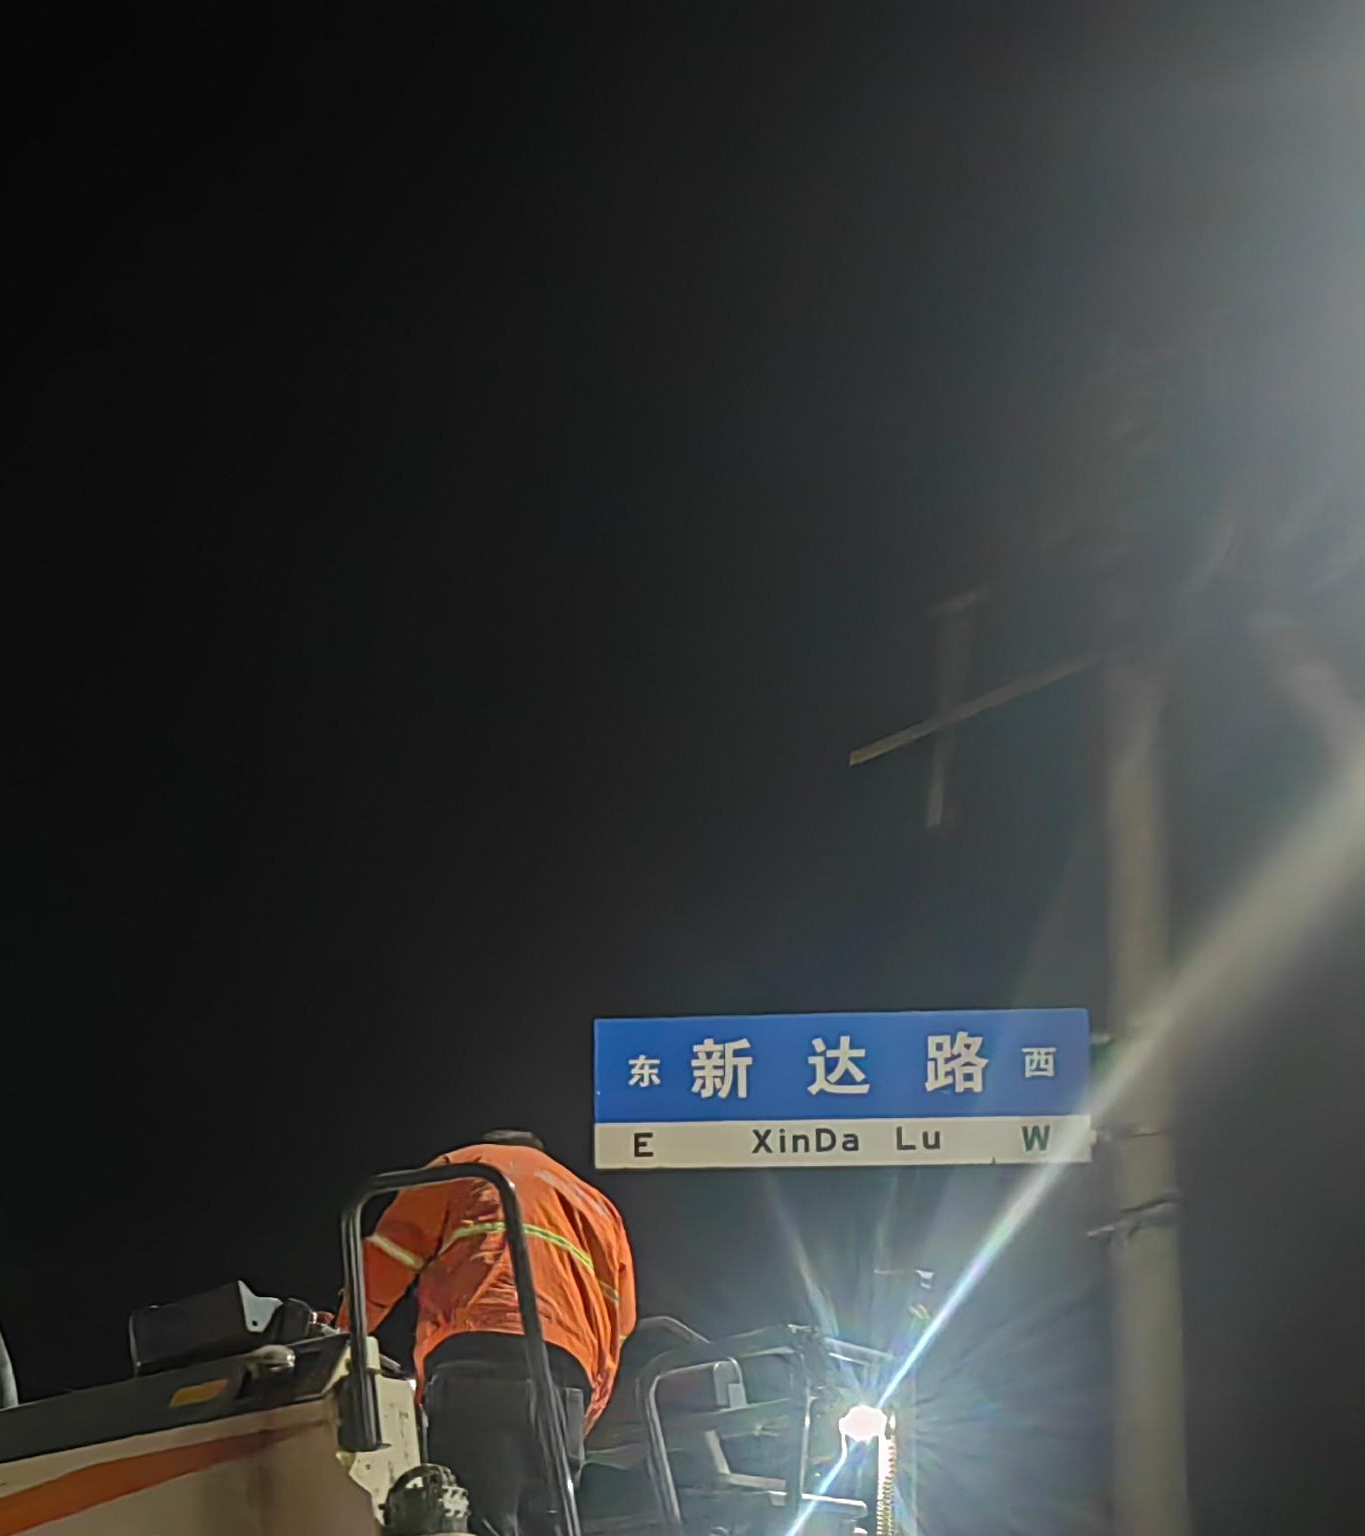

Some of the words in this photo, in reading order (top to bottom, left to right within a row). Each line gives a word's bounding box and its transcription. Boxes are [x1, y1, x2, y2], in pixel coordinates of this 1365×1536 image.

[628, 1055, 661, 1087] 东
[691, 1031, 989, 1098] 新达路
[1021, 1047, 1057, 1078] 西
[634, 1132, 654, 1157] E
[752, 1127, 859, 1154] XinDa
[896, 1126, 941, 1151] Lu
[1022, 1125, 1051, 1151] W
